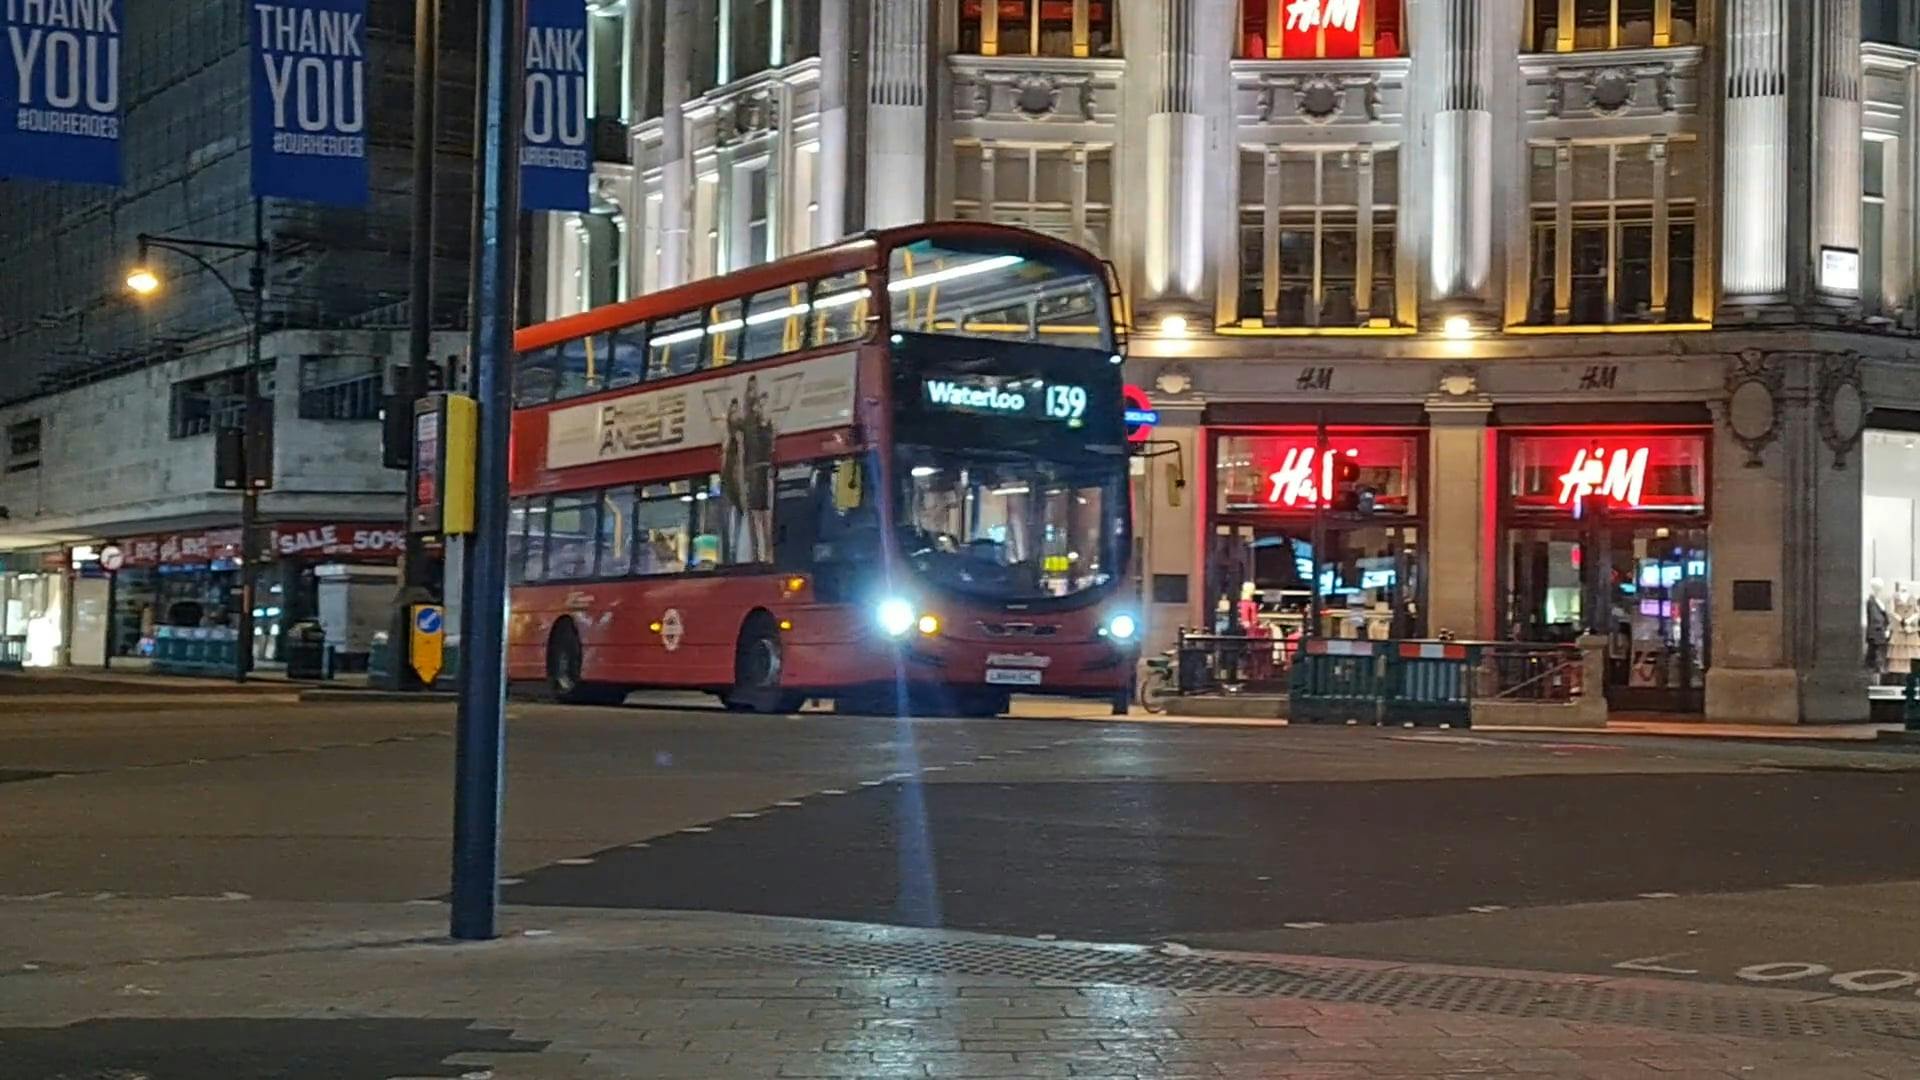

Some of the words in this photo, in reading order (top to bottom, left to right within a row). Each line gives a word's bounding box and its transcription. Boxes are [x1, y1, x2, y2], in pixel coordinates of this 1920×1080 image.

[254, 3, 362, 57] THANK
[525, 26, 584, 72] ANK
[7, 26, 119, 113] YOU
[262, 53, 363, 133] YOU
[524, 72, 585, 145] OU
[17, 108, 118, 139] #OURHEROES
[273, 131, 364, 158] #OURHEROES
[927, 380, 1025, 410] Waterloo
[1046, 385, 1087, 418] 139
[279, 525, 337, 554] SALE
[1612, 952, 1920, 997] LOO
